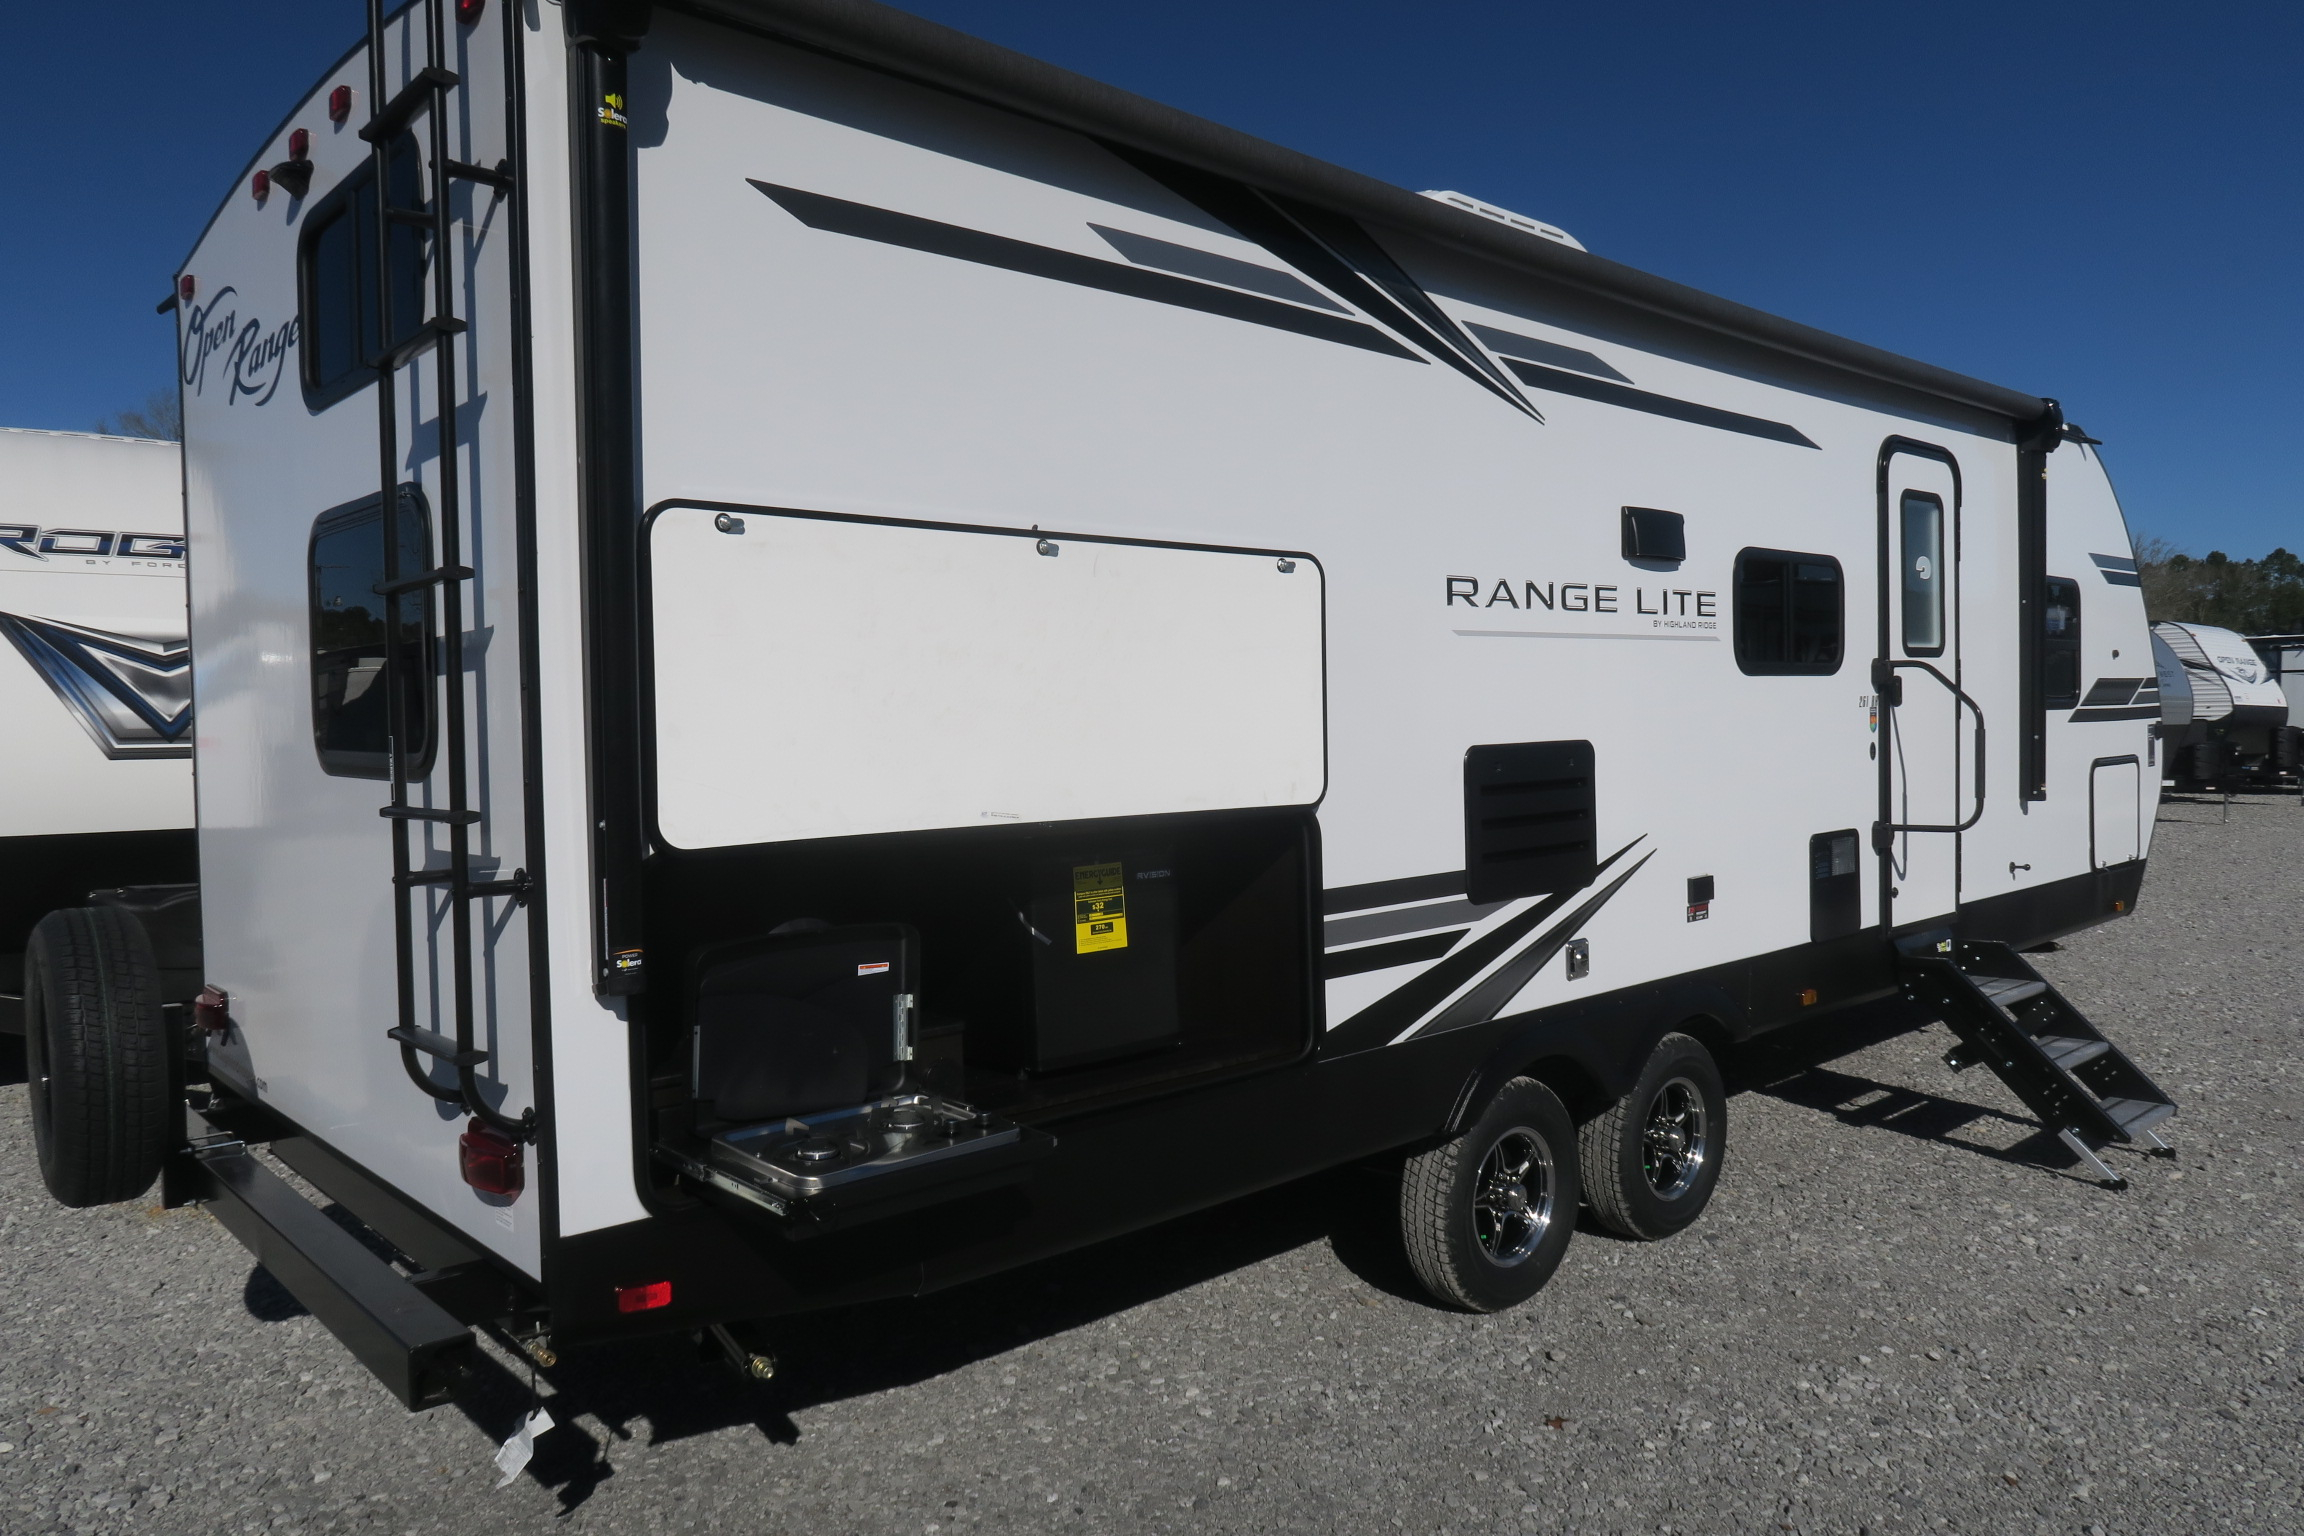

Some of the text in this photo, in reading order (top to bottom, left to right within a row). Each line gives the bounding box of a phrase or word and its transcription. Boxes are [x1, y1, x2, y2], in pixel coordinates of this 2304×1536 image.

[184, 286, 238, 397] Open
[223, 313, 300, 407] Range
[1446, 575, 1716, 617] RANGE LITE
[1653, 620, 1717, 630] BY HIGHLAND RIDGE
[1092, 902, 1105, 910] $32
[616, 959, 642, 968] Solera
